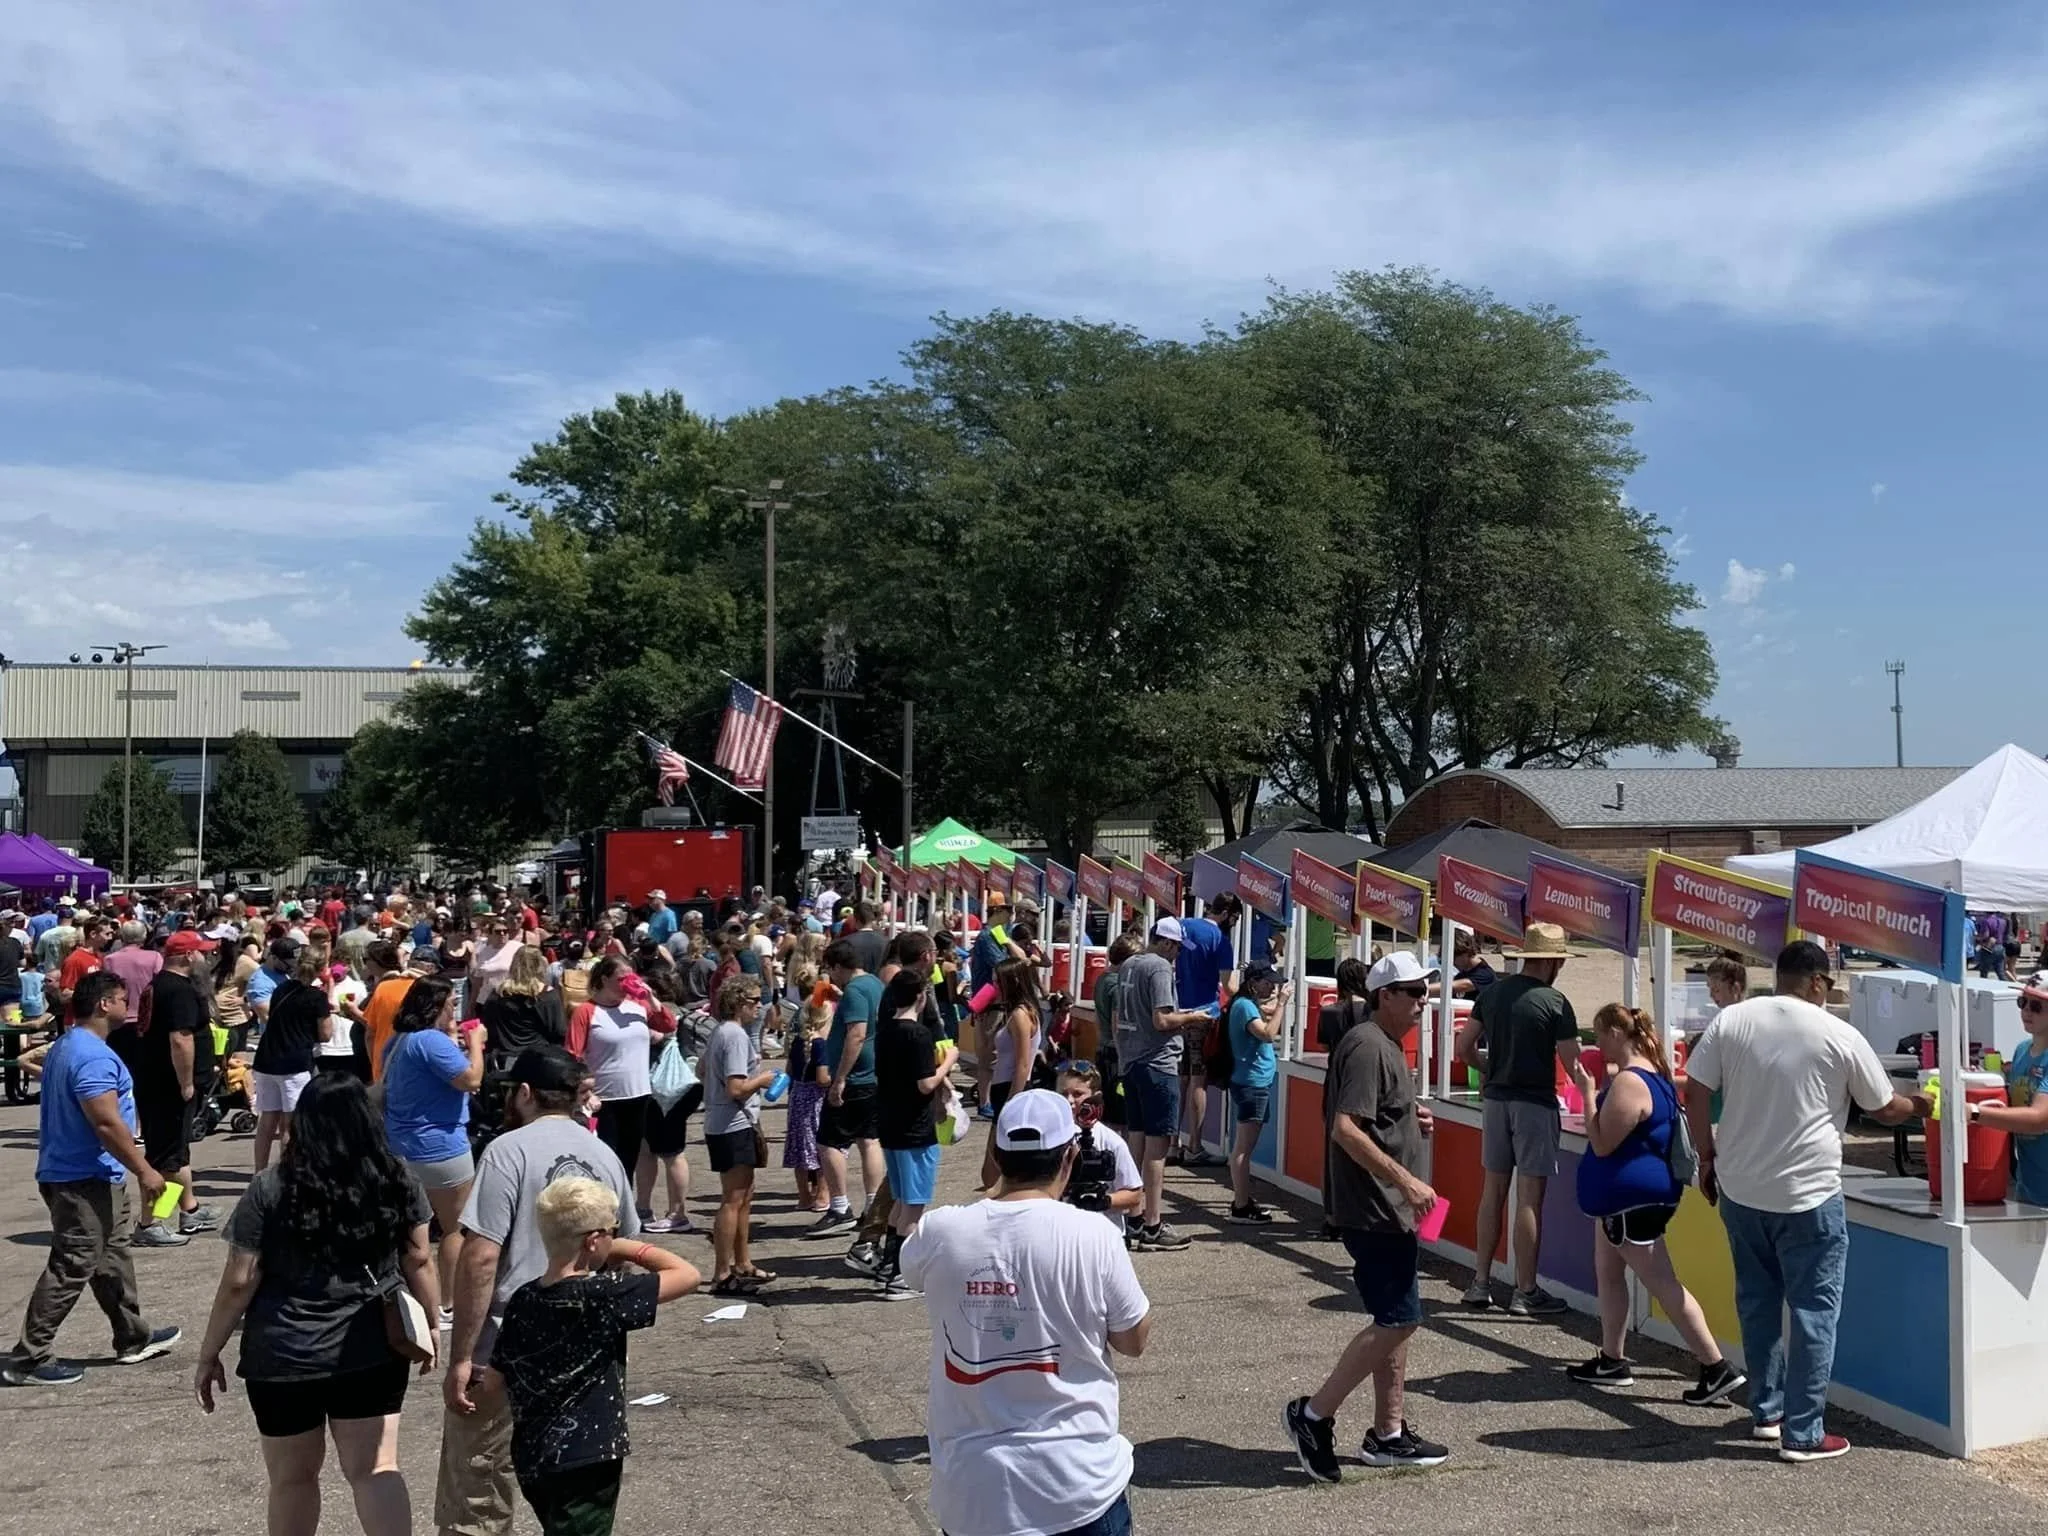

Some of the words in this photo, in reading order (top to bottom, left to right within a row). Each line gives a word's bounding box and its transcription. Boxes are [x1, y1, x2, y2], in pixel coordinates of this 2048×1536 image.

[1251, 879, 1283, 906] Raspberry
[1295, 869, 1311, 889] Pink
[1310, 879, 1351, 911] Lemonade
[1365, 883, 1387, 905] Peach
[1453, 880, 1509, 918] Strawberry
[1544, 885, 1582, 911] Lemon
[1584, 895, 1612, 920] Lime
[1673, 873, 1762, 920] Strawberry
[1675, 903, 1757, 945] Lemonade
[1805, 887, 1872, 922] Tropical
[1875, 904, 1932, 938] Punch
[966, 1280, 1019, 1298] HERO
